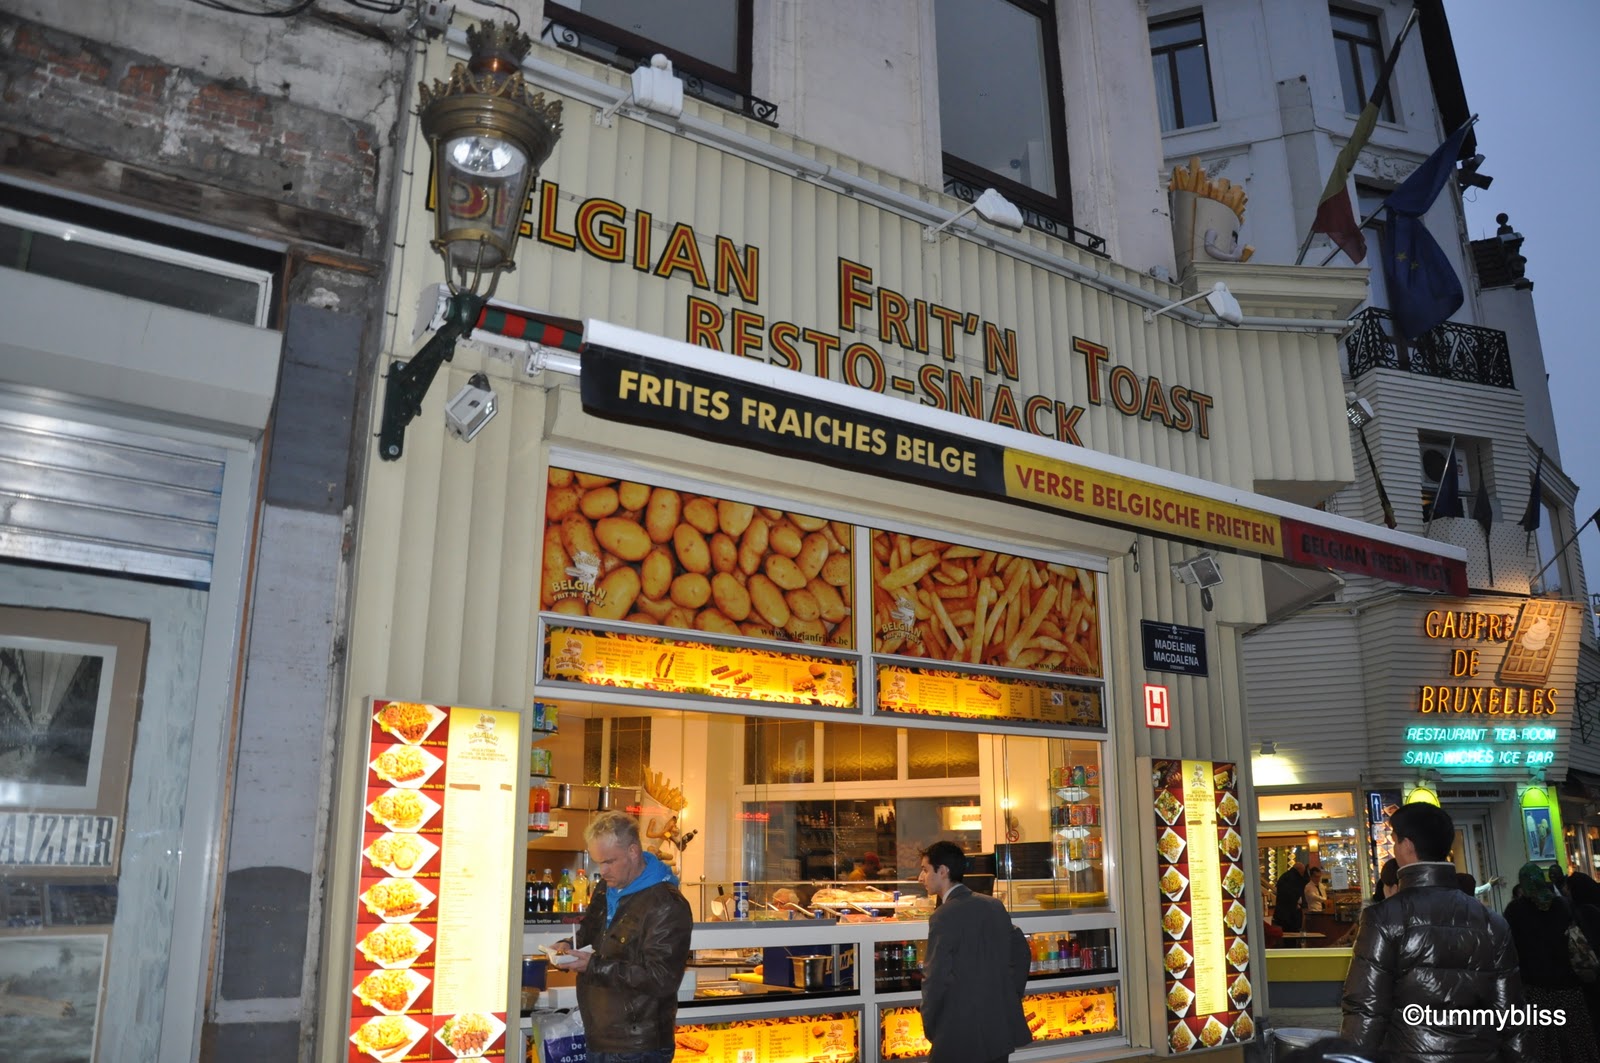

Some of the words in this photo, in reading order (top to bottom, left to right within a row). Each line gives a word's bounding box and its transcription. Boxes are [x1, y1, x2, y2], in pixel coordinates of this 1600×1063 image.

[1072, 335, 1213, 440] TOAST
[618, 369, 730, 421] FRITES
[741, 398, 887, 456] FRAICHES
[896, 435, 977, 478] BELGE
[1015, 464, 1084, 503] VERSE
[1092, 482, 1200, 531] BELGISCHE
[1206, 511, 1276, 547] FRIETEN
[1302, 534, 1367, 566] BELGIAN
[1371, 551, 1412, 576] FRESH
[552, 579, 607, 600] BELGIAN
[881, 621, 922, 638] BELGIAN
[1154, 638, 1197, 654] MADELEINE
[1153, 651, 1200, 666] MAGDALENA
[1451, 648, 1481, 677] DE
[1149, 689, 1165, 723] H
[1419, 686, 1559, 715] BRUXELLES
[1407, 727, 1488, 741] RESTAURANT
[1494, 727, 1556, 741] TEA-ROOM
[1405, 750, 1494, 764] SANDWICHES
[1499, 751, 1521, 764] ICE
[1526, 751, 1554, 763] BAR
[1290, 803, 1323, 811] ICE-BAR
